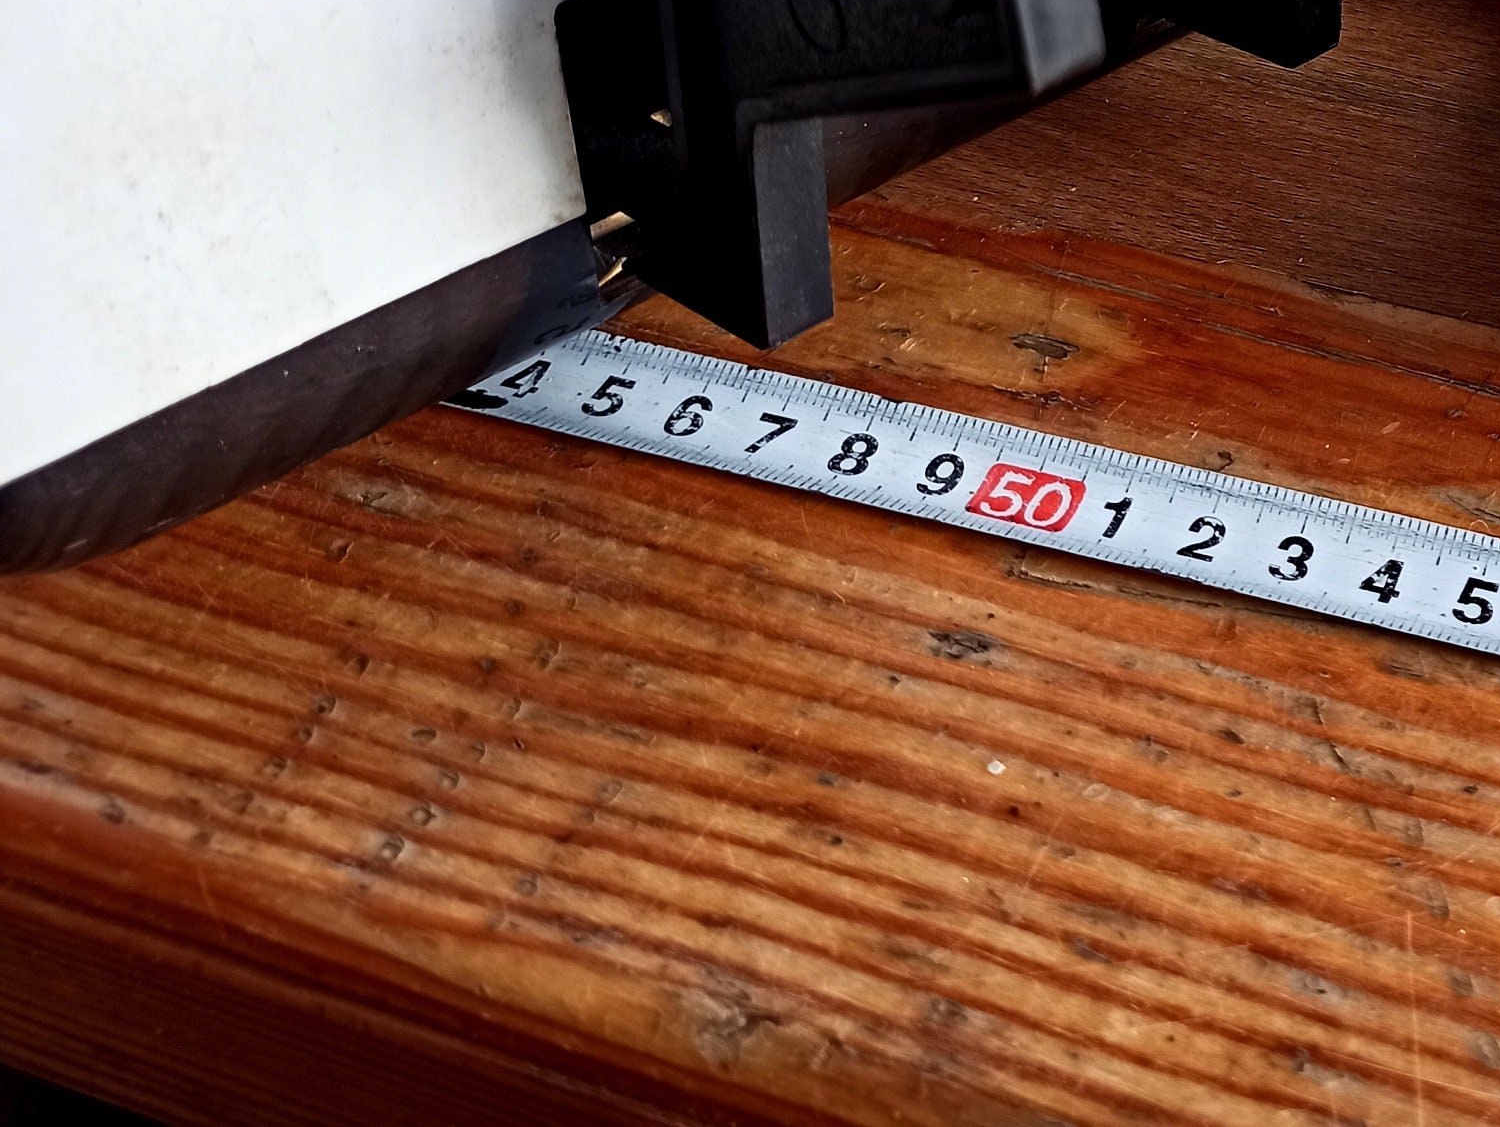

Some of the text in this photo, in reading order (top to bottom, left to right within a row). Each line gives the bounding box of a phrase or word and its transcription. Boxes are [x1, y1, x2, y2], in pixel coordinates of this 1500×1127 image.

[500, 360, 552, 398] 4
[581, 375, 637, 417] 5
[663, 396, 714, 437] 6
[744, 412, 799, 454] 7
[828, 432, 879, 476] 8
[916, 453, 966, 496] 9
[979, 471, 1072, 529] 50
[1101, 497, 1134, 539] 1
[1176, 515, 1227, 563] 2
[1268, 535, 1315, 582] 3
[1360, 559, 1405, 605] 4
[1452, 578, 1500, 625] 5
